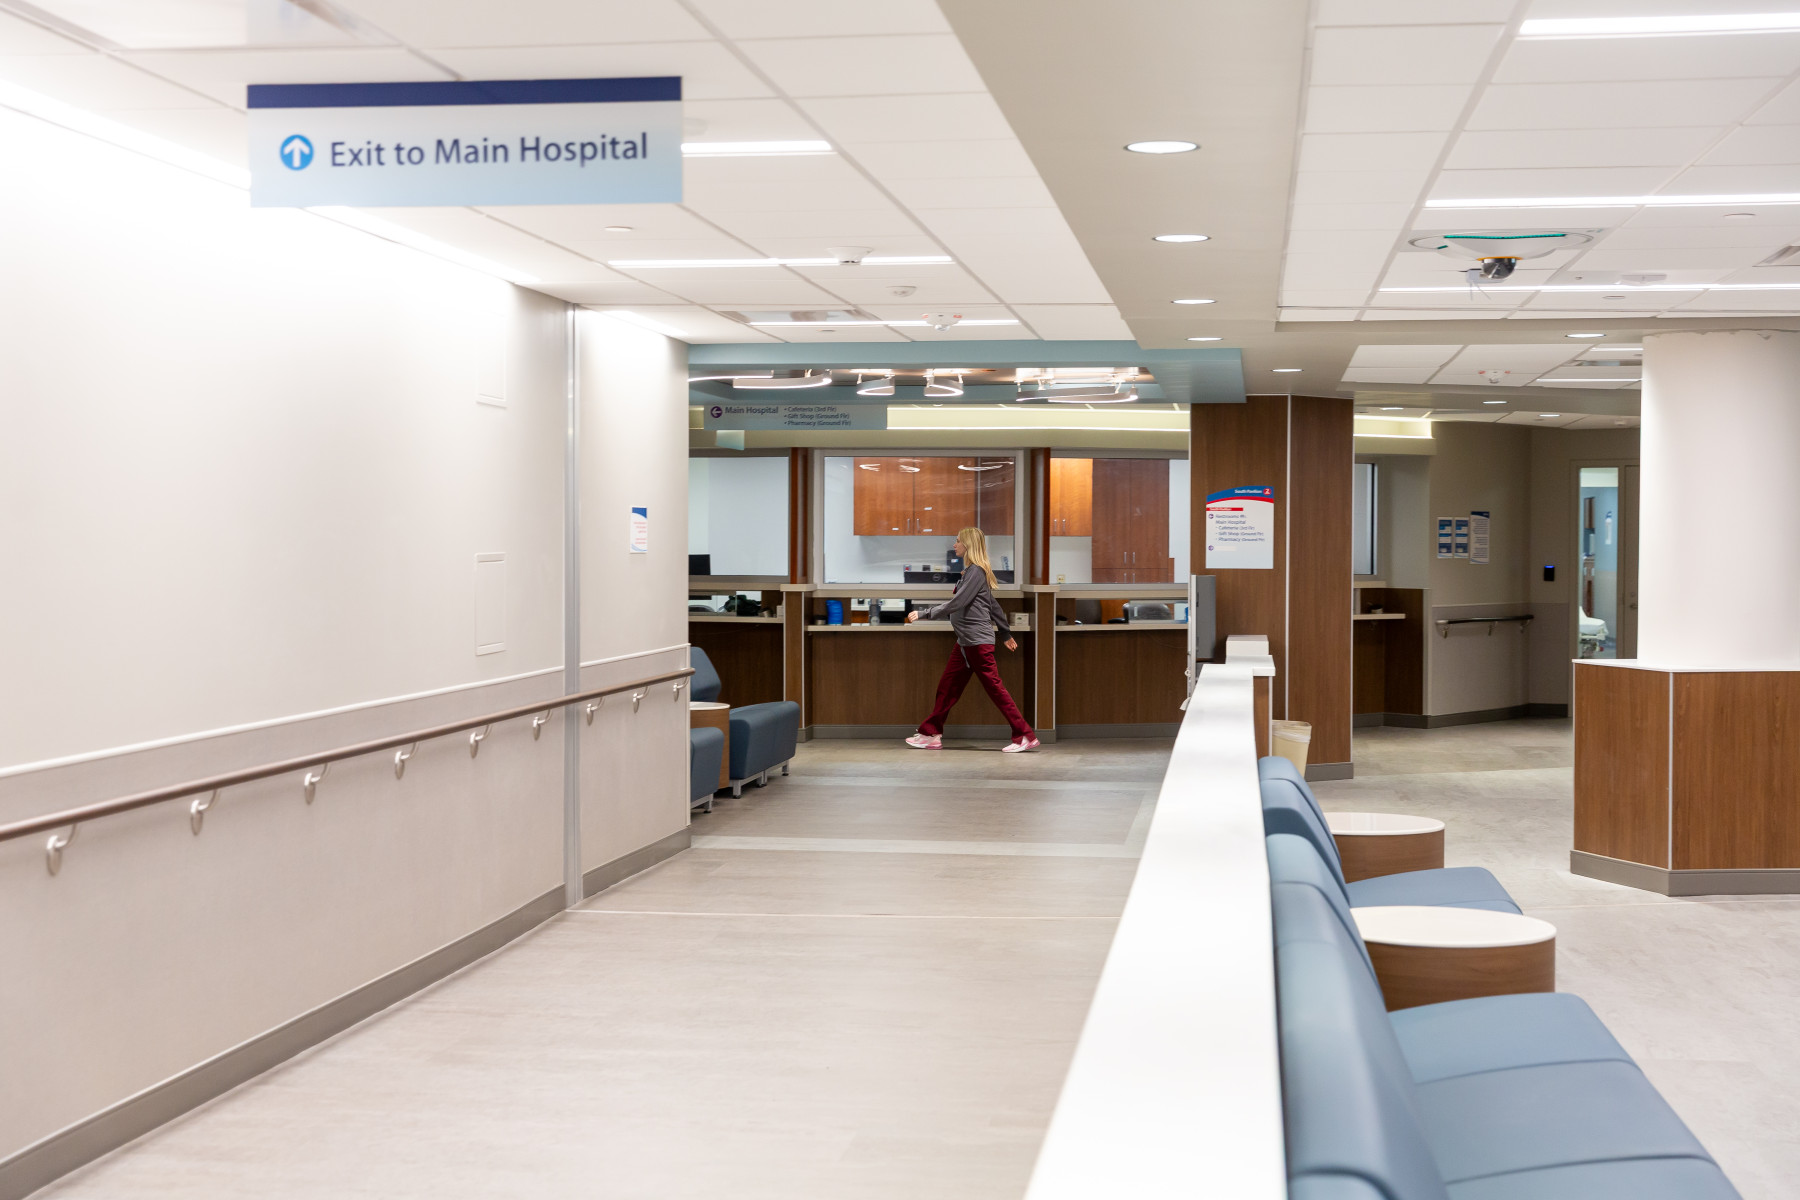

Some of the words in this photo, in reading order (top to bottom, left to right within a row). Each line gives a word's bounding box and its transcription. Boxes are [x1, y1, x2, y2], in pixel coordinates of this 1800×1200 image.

[330, 141, 385, 167] Exit
[395, 142, 425, 165] to
[435, 137, 509, 165] Main
[520, 132, 648, 167] Hospital
[746, 406, 778, 415] Hospital
